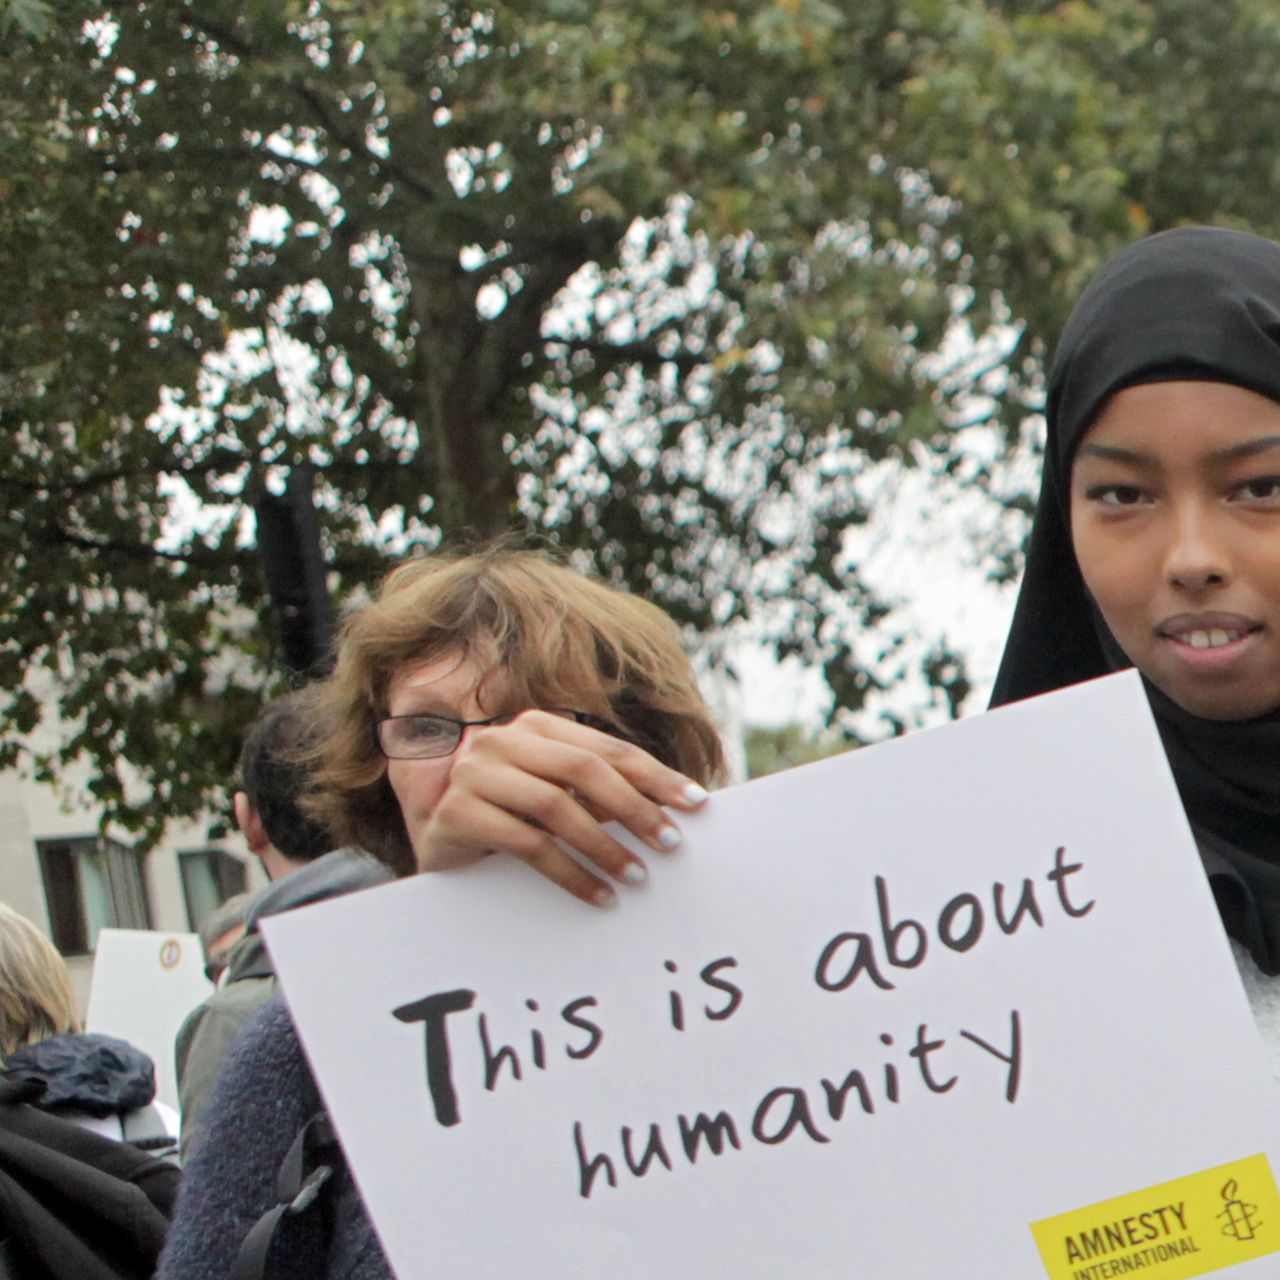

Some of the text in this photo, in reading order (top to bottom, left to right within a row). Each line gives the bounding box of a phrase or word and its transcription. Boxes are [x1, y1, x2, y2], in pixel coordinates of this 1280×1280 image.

[391, 847, 1095, 1128] This is about
[573, 1010, 1021, 1199] humanity
[1064, 1201, 1188, 1265] AMNESTY
